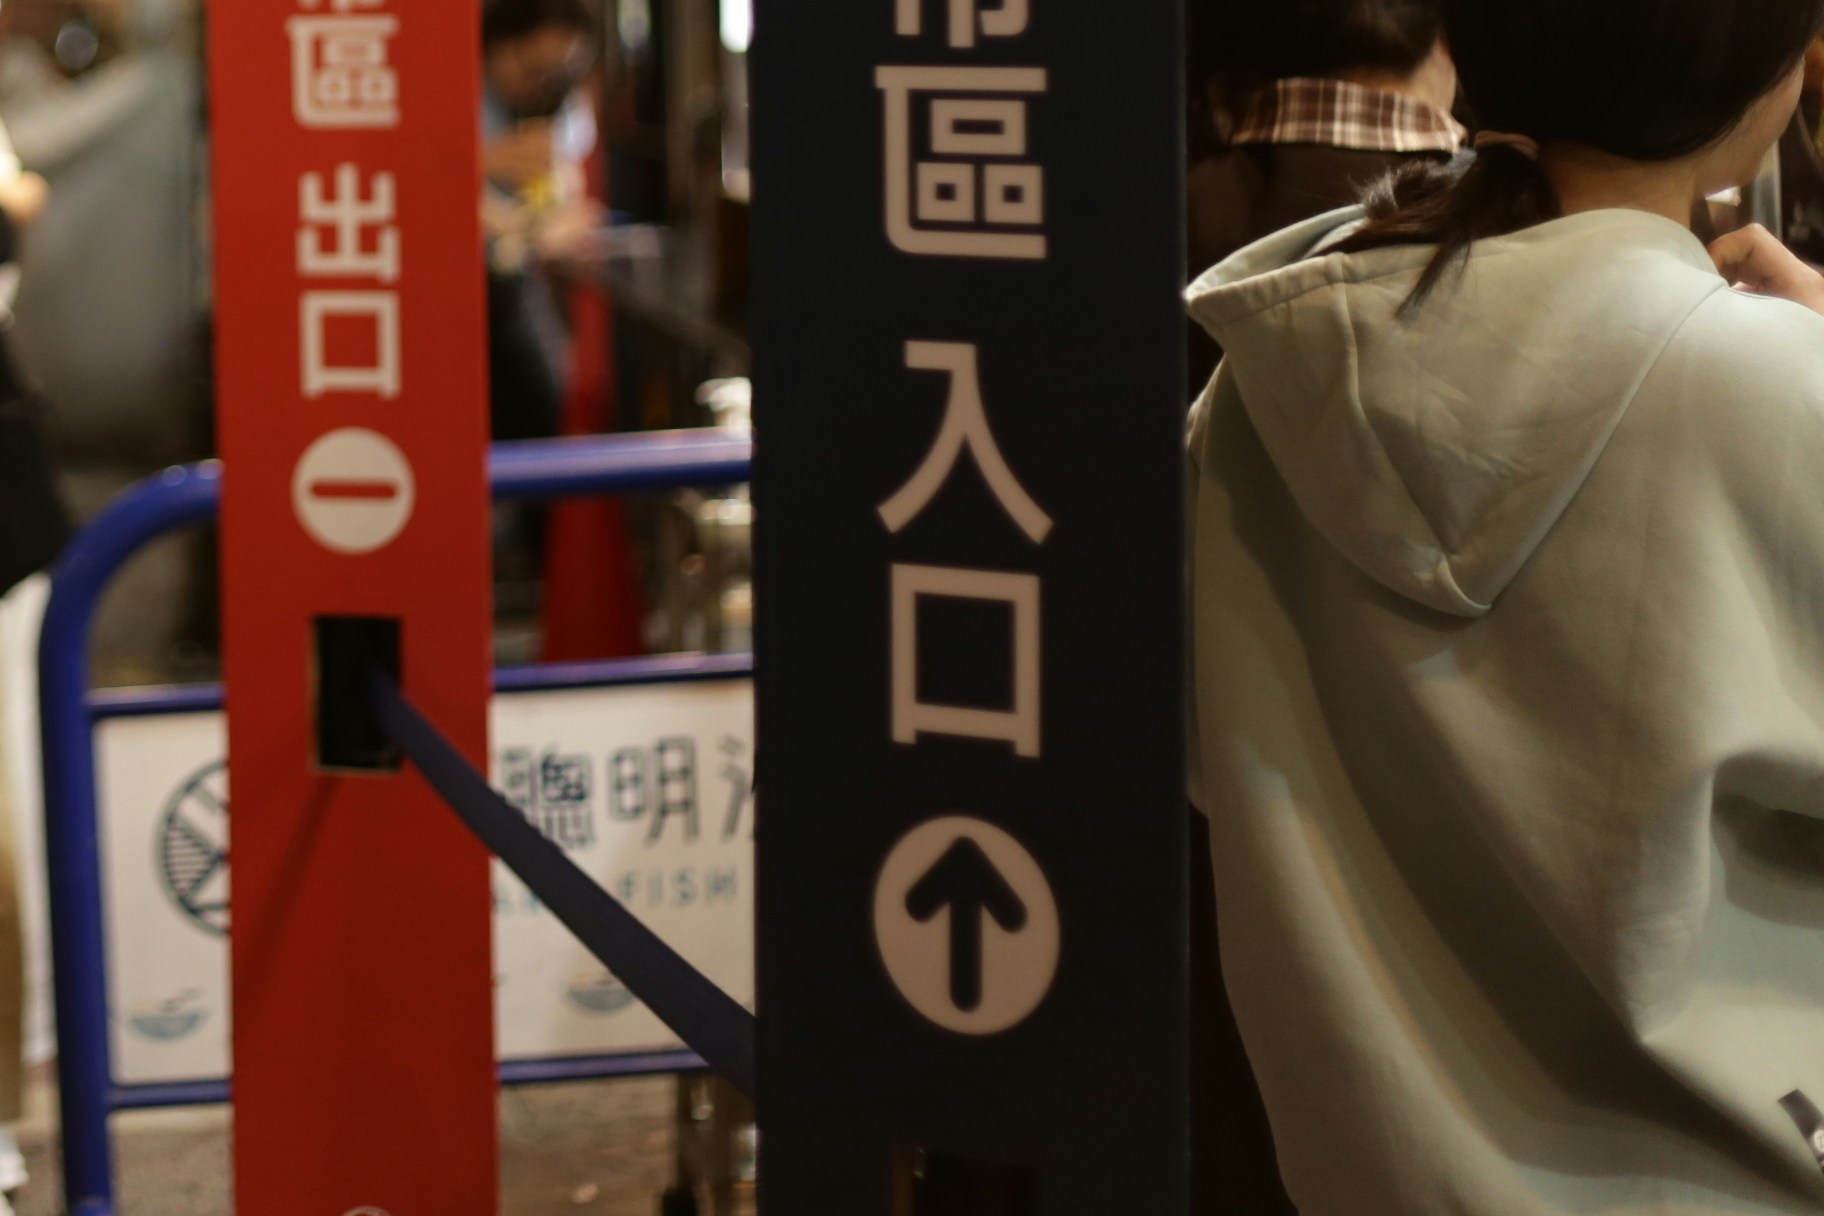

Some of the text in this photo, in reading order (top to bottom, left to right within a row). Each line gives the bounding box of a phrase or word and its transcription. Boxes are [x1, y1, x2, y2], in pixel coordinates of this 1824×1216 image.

[295, 162, 402, 399] 出口
[876, 339, 1053, 759] 入口
[614, 865, 739, 910] FISH
